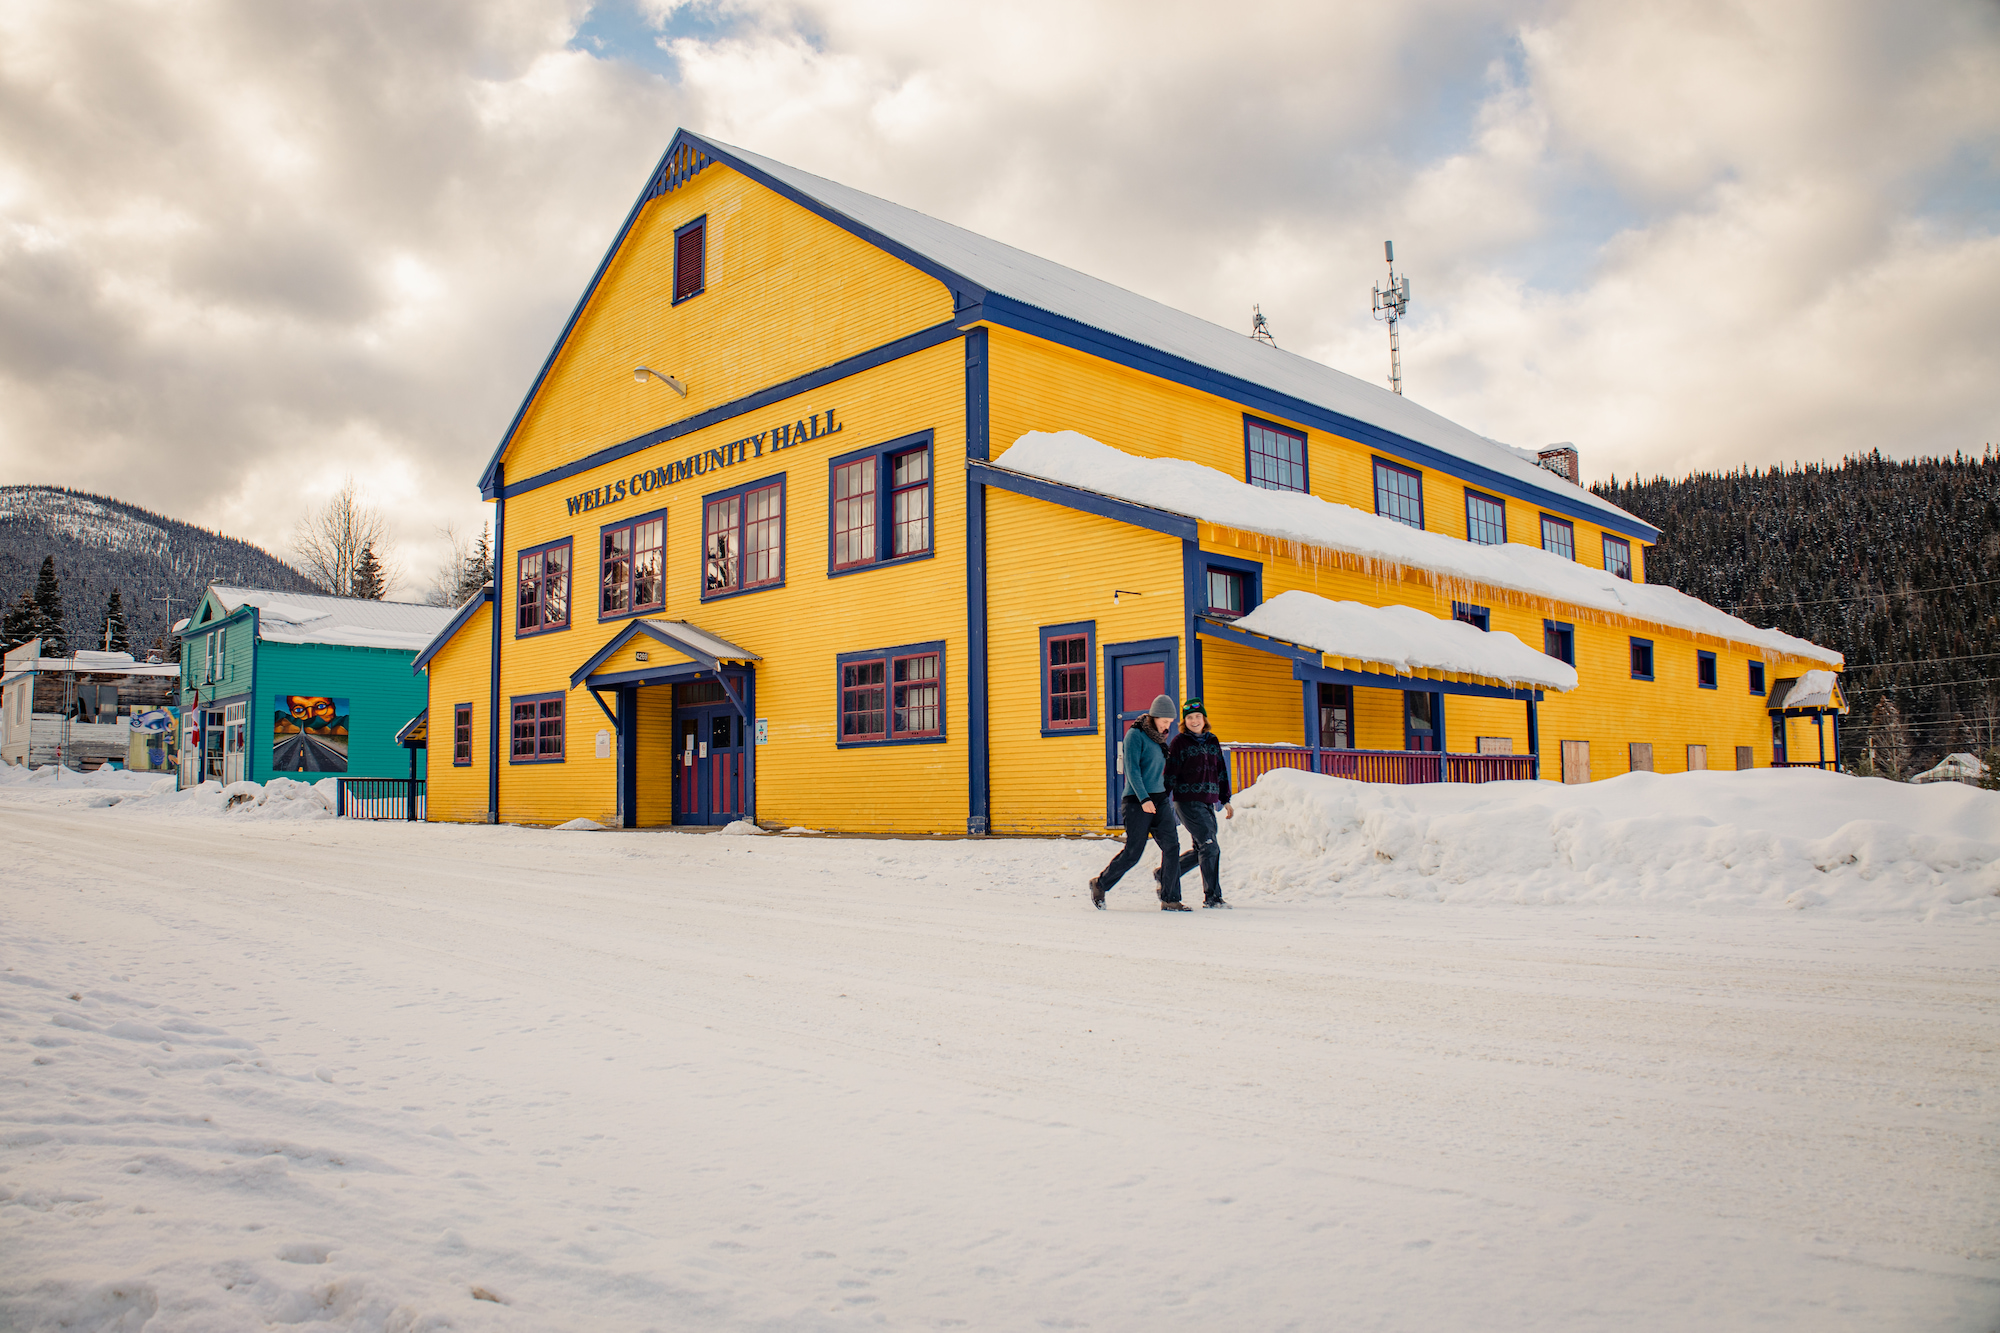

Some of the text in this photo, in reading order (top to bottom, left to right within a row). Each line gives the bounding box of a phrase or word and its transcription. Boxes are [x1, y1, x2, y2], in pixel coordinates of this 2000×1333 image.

[566, 408, 843, 516] WELLS COMMUNITY HALL
